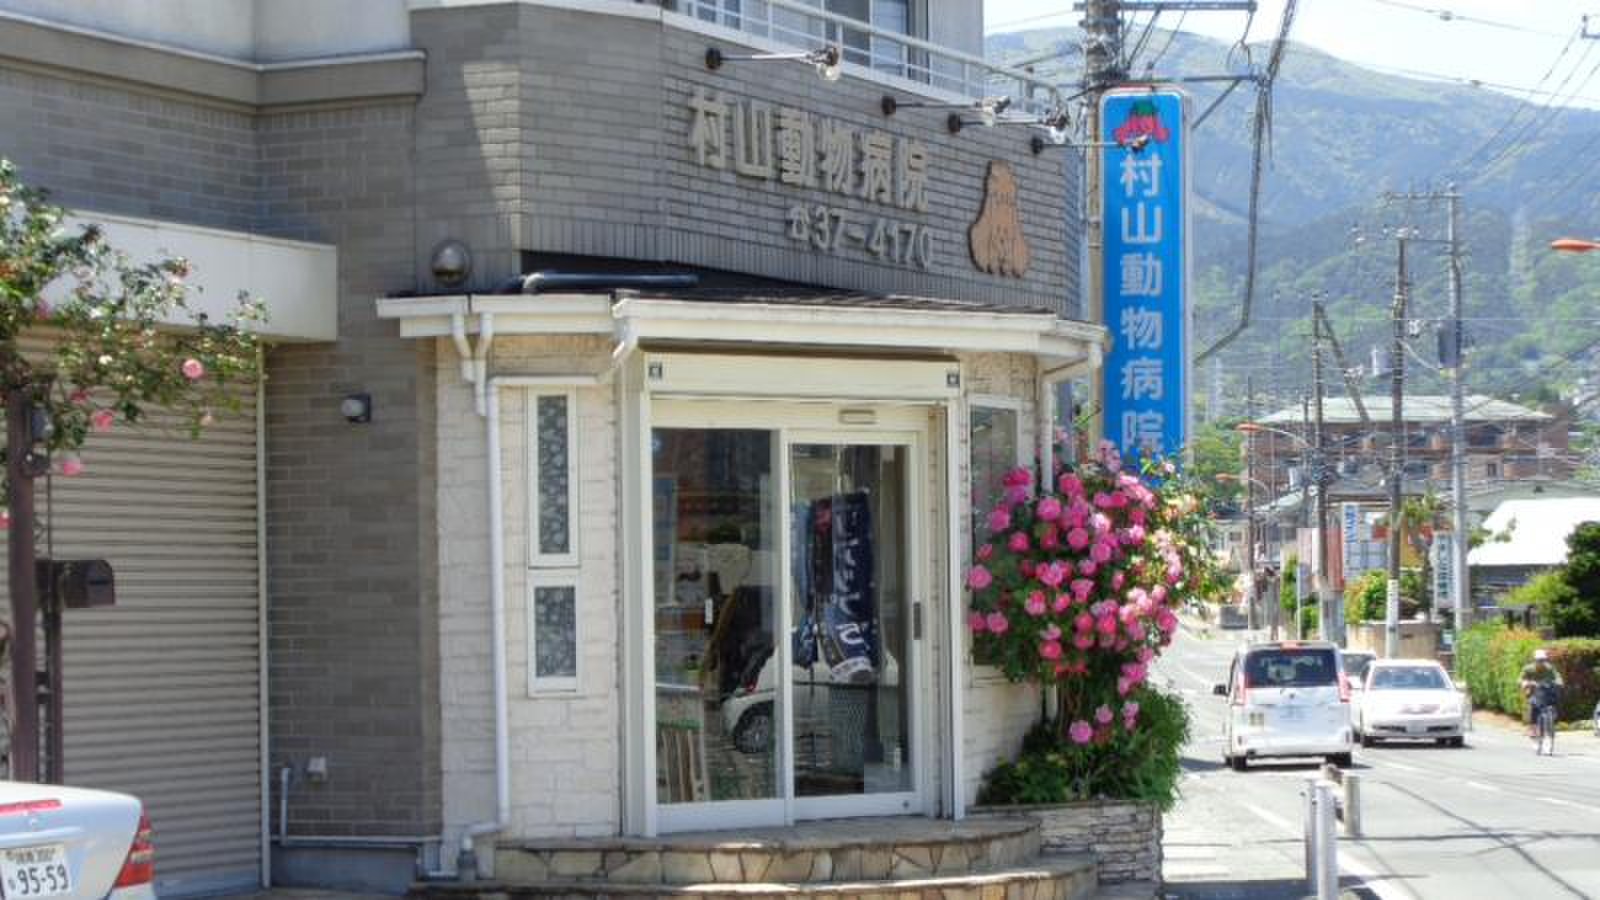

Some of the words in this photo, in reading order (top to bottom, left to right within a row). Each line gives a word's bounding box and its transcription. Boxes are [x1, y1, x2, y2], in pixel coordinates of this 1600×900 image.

[689, 85, 930, 214] 村山動物病院
[1119, 153, 1164, 453] 村山動物病院
[17, 864, 70, 895] 95-59
